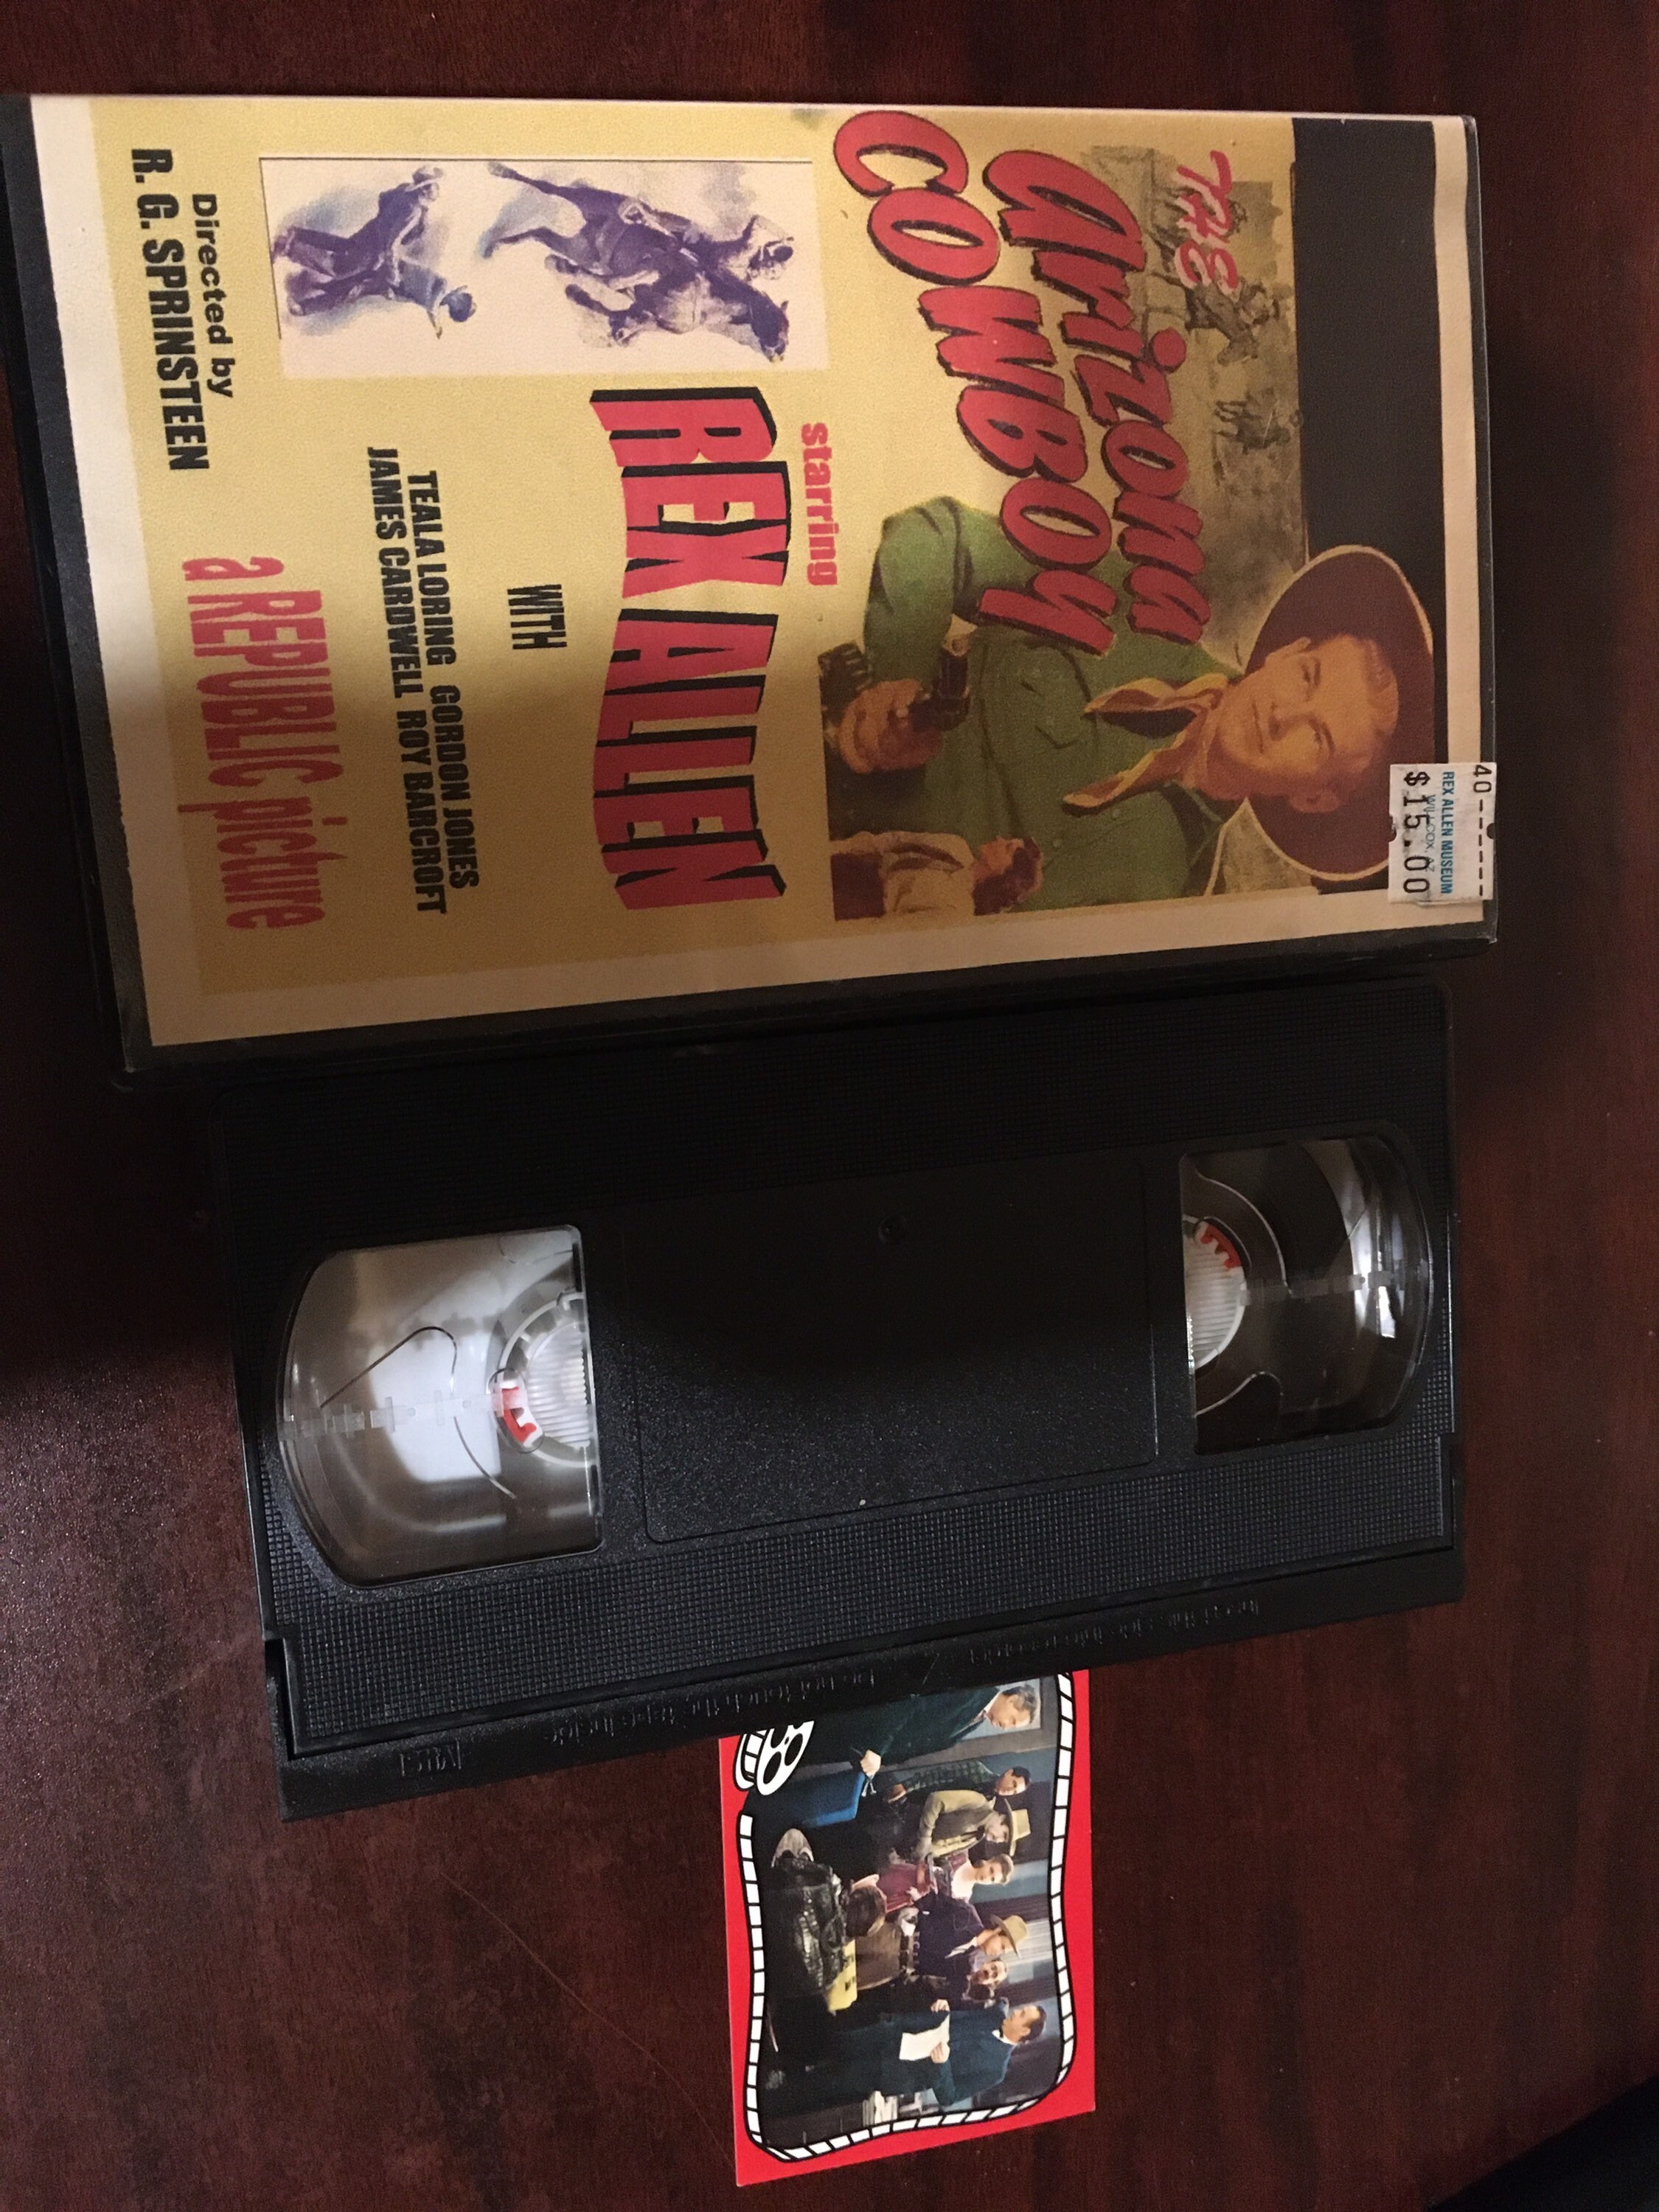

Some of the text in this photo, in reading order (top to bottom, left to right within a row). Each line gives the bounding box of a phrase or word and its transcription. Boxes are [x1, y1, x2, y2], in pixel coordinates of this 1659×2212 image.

[131, 149, 210, 471] R. G. SPRINSTEEN
[192, 193, 235, 398] Directed by
[507, 584, 568, 650] WITH
[800, 422, 840, 586] starring
[178, 556, 348, 929] a REPUBLIC picture
[367, 446, 447, 914] JAMES CARDWELL ROY BARCROFT
[408, 470, 480, 890] TEALA LORING GORDON JONES
[590, 386, 791, 911] REX ALLEN
[1403, 771, 1430, 894] $15.00
[1440, 771, 1455, 894] REX ALLEN MUSEUM
